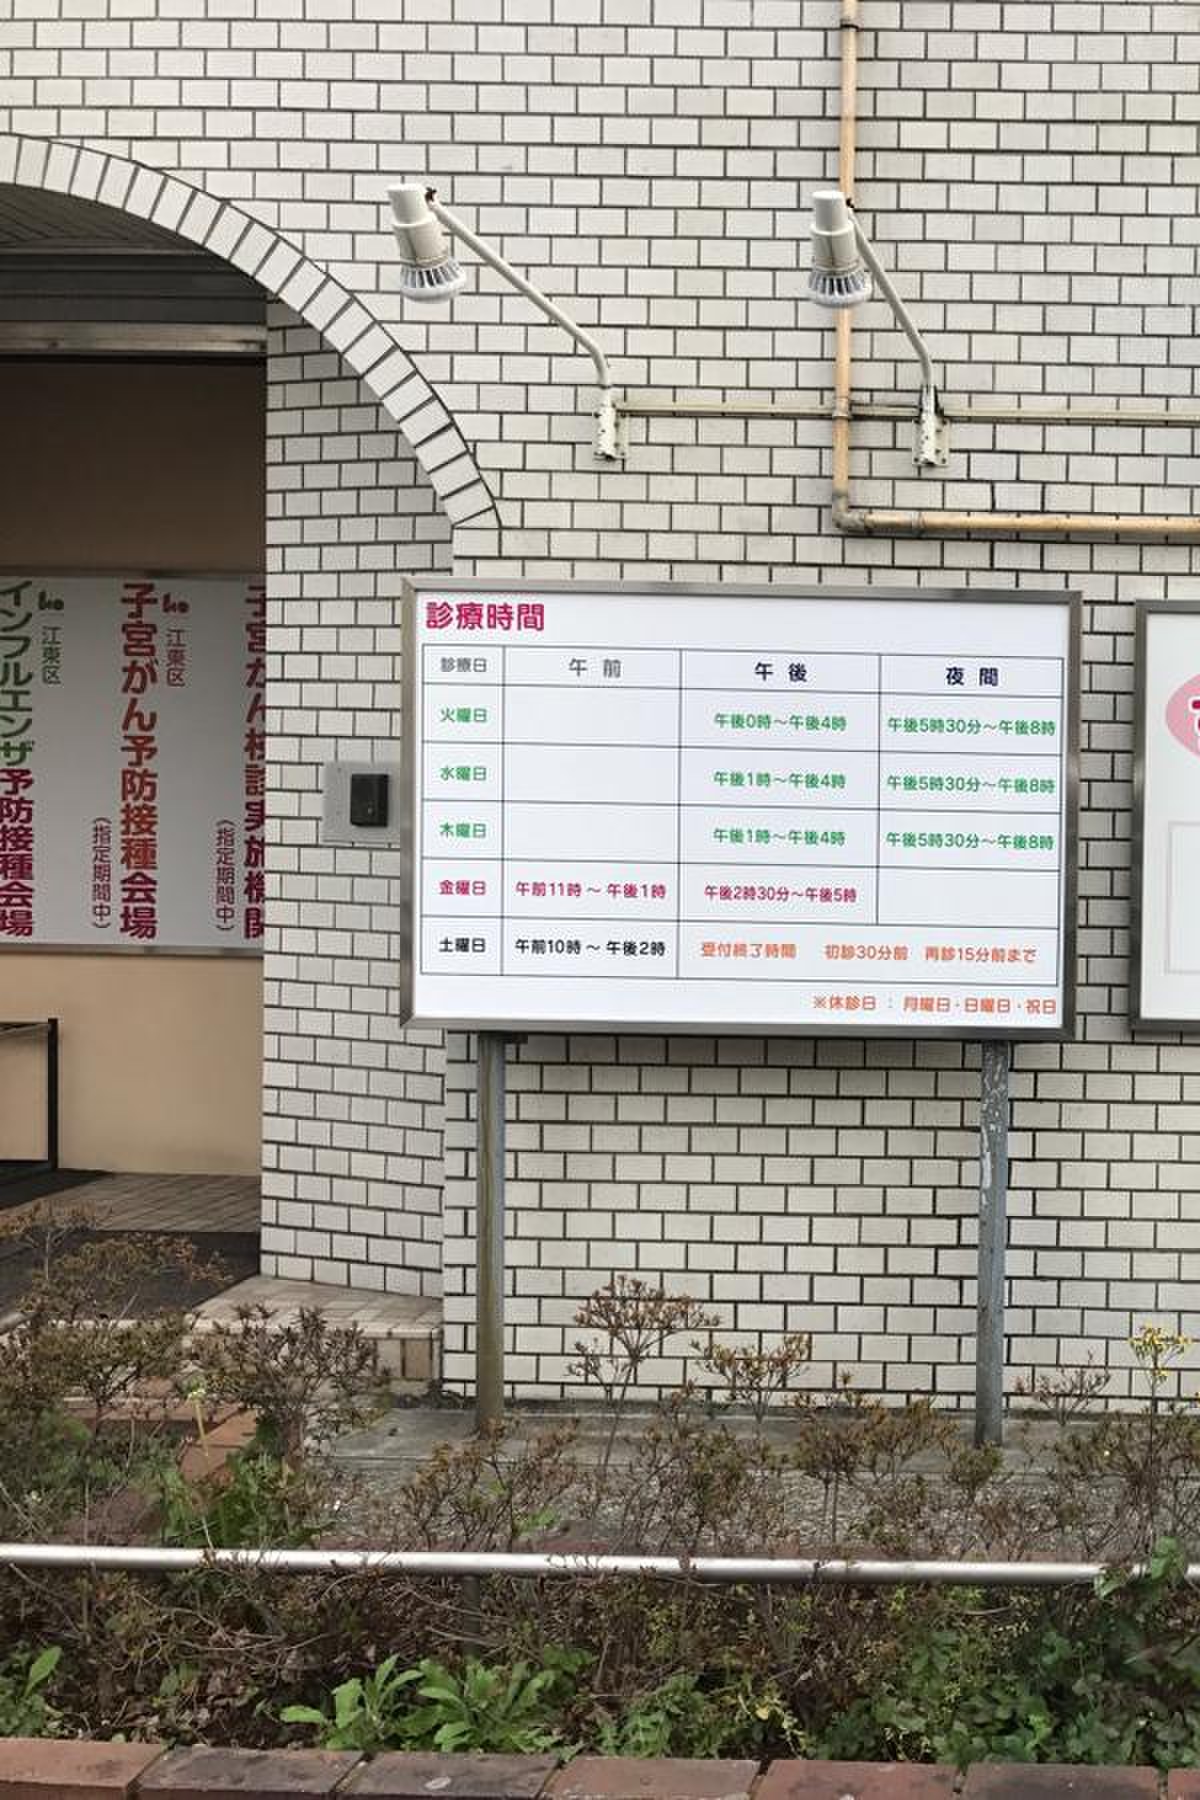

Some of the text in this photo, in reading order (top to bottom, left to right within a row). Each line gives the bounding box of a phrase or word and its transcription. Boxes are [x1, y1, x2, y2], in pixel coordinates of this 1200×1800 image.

[426, 601, 545, 631] 診療時間
[42, 626, 62, 684] 江東区
[166, 628, 186, 687] 江東区
[440, 657, 487, 673] 診療日
[440, 708, 487, 723] 火曜日
[121, 583, 158, 939] 子宮がん予防接種会場
[440, 766, 487, 781] 水曜日
[440, 823, 487, 838] 木曜日
[439, 880, 486, 895] 金曜日
[439, 938, 486, 953] 土曜日
[701, 943, 1036, 964] 受付終了時間 初診30分前 再診15分前まで
